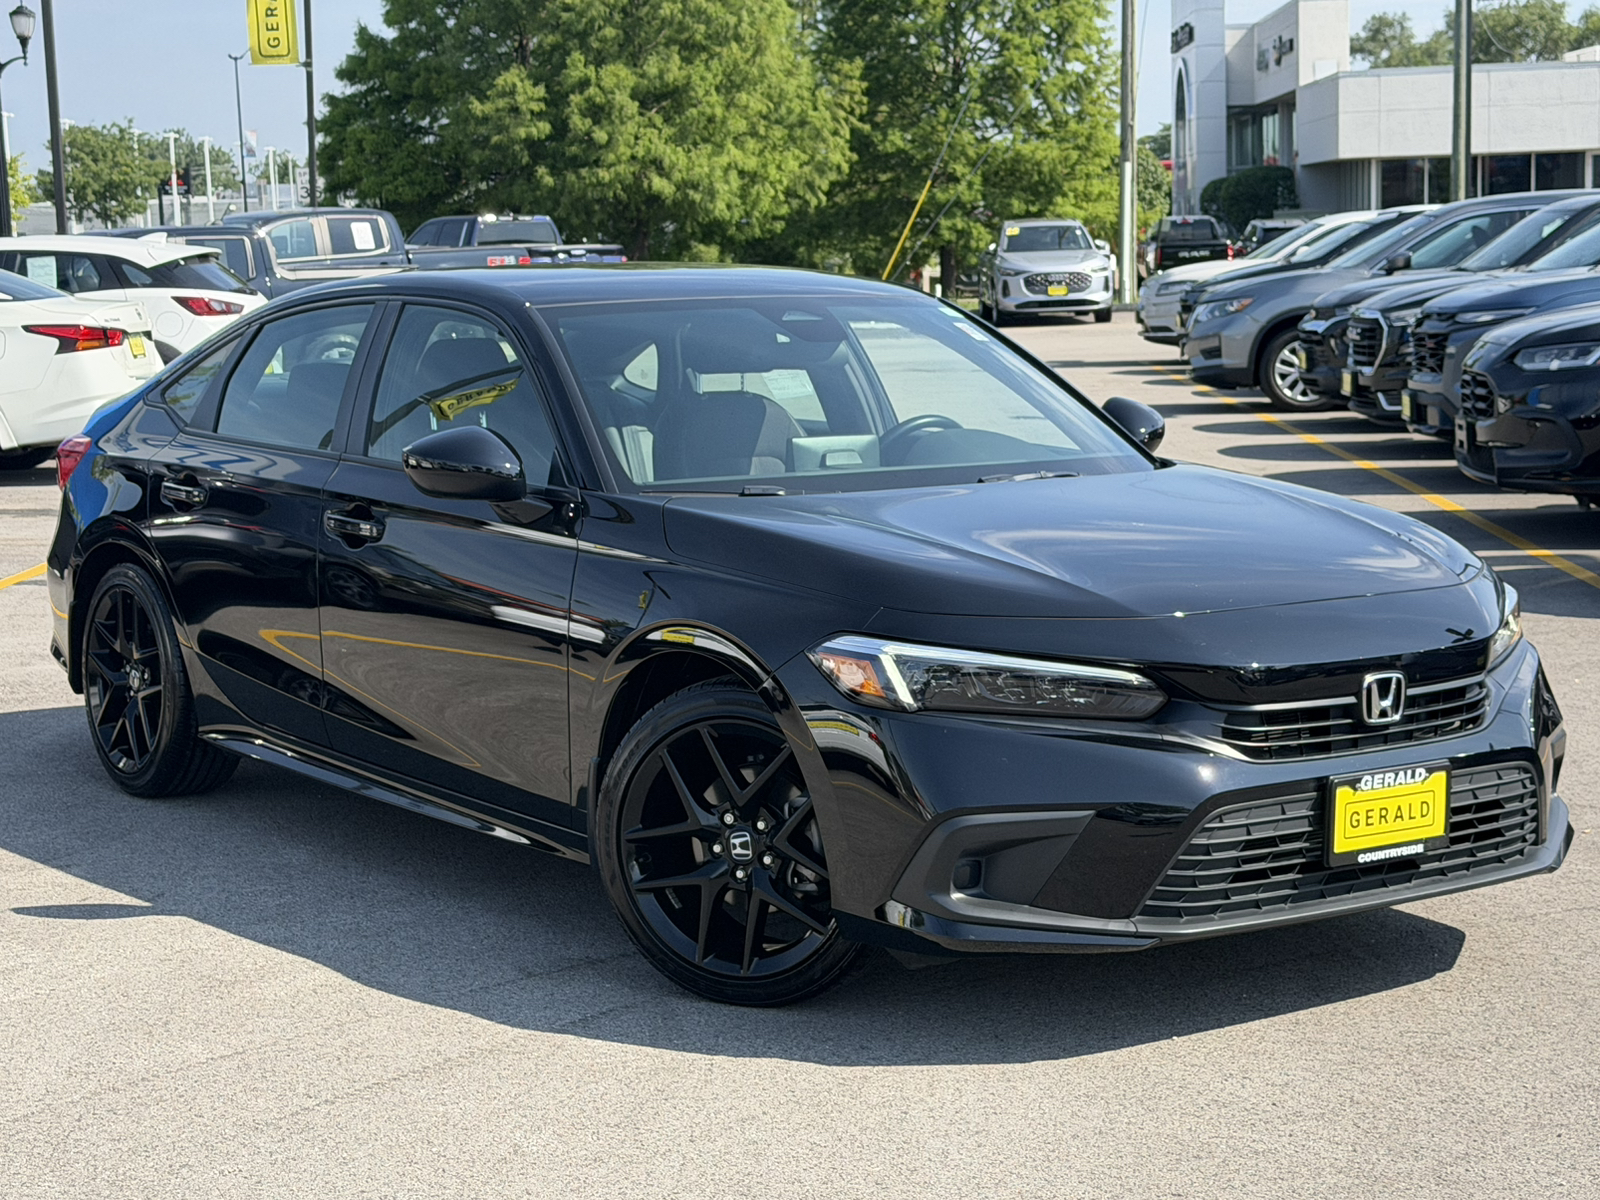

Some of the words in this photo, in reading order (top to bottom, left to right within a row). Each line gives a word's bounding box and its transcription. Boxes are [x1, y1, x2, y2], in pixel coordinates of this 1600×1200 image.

[265, 0, 281, 48] GER
[1360, 767, 1426, 791] GERALD
[1349, 801, 1430, 829] GERALD
[1357, 843, 1424, 863] COUNTRYSIDE
